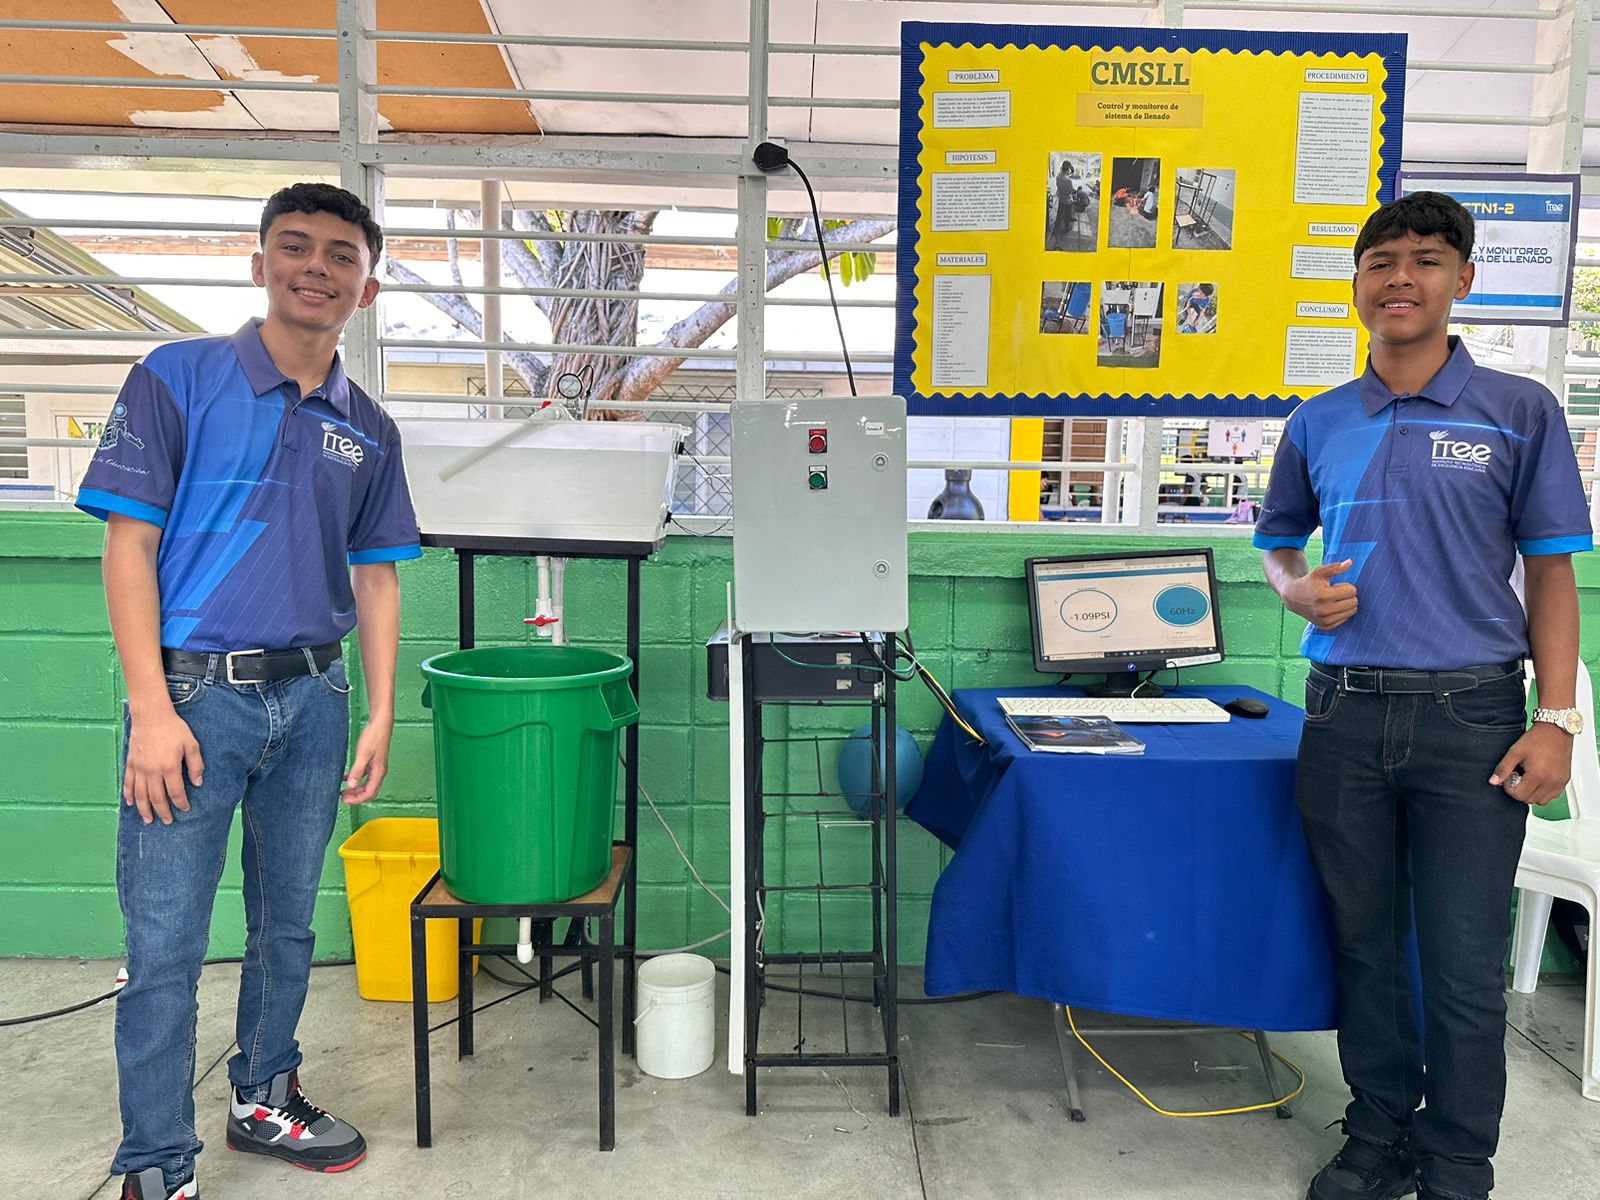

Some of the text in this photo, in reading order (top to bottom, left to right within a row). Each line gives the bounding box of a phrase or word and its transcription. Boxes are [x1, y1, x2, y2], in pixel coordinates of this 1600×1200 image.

[955, 72, 994, 80] PROBLEMA
[1091, 61, 1190, 86] CMSLL
[1307, 72, 1365, 80] PROCEDIMIENTO
[1097, 102, 1124, 110] Control
[1144, 112, 1170, 120] llenado
[951, 153, 988, 161] HIPÓTESIS
[1486, 247, 1548, 255] MONITOREO
[940, 256, 984, 264] MATERIALES
[1486, 255, 1500, 263] DE
[1502, 255, 1552, 264] LLENADO
[1300, 305, 1345, 313] CONCLUSIÓN
[1169, 607, 1196, 615] 60Hz
